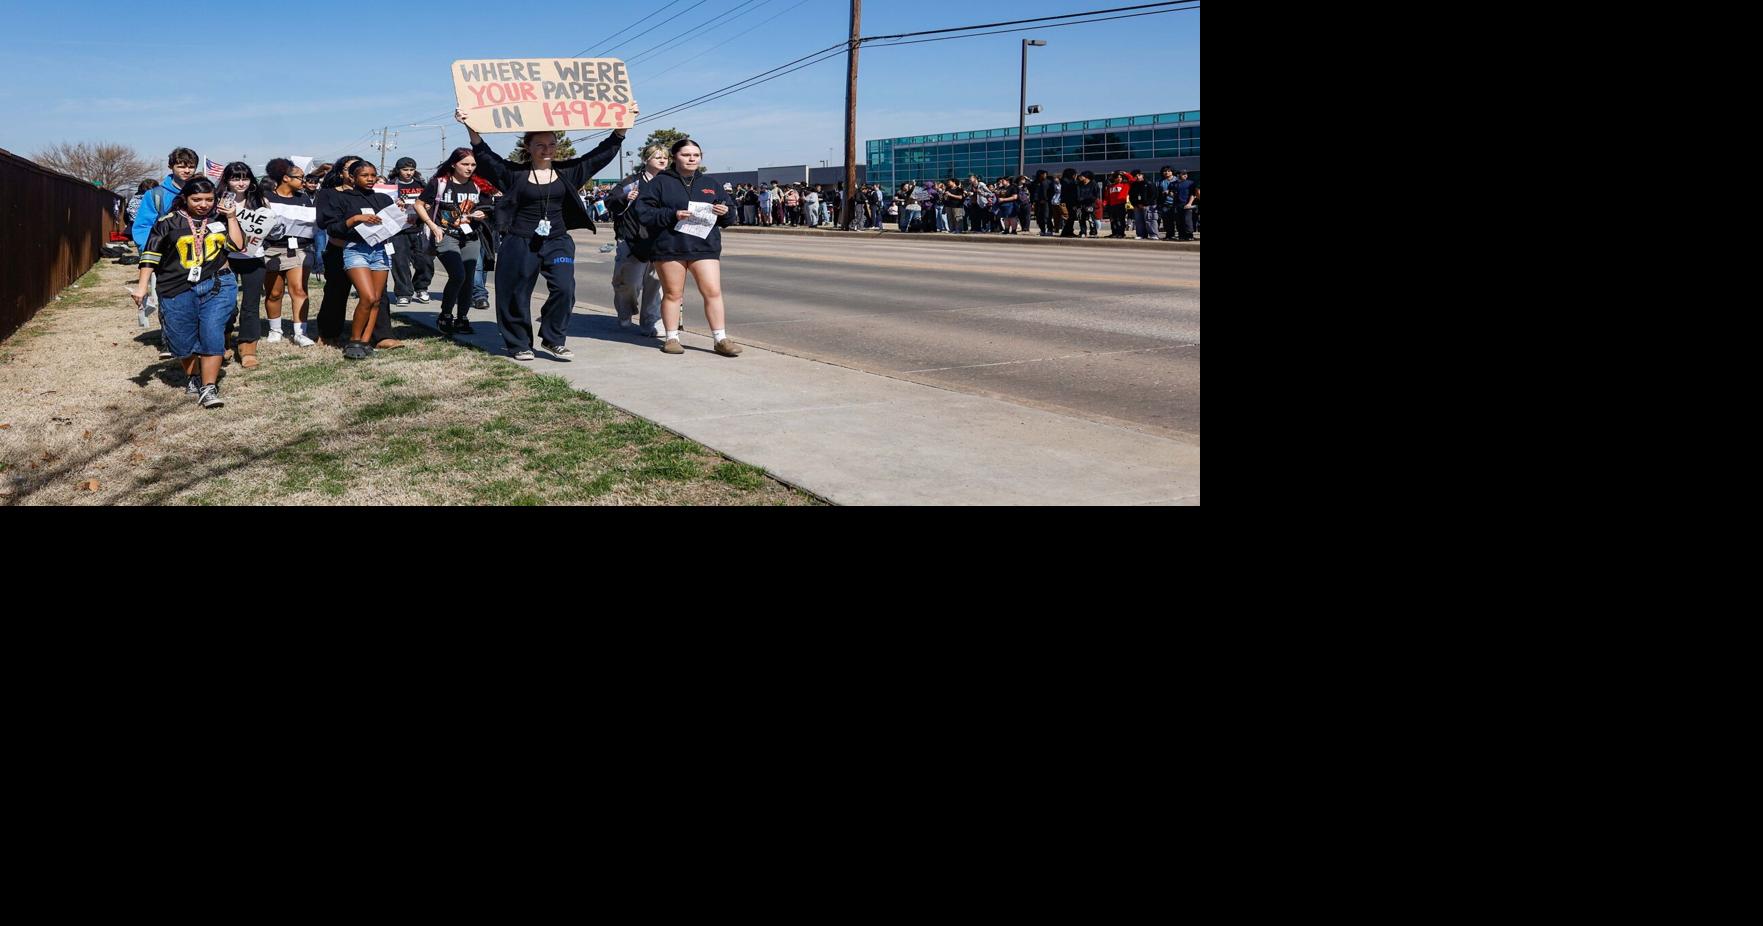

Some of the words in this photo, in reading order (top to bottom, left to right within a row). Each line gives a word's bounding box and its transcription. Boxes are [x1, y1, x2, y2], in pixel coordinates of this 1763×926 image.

[460, 61, 541, 82] WHERE
[553, 61, 628, 84] WERE
[468, 82, 538, 107] YOUR
[541, 81, 629, 104] PAPERS
[492, 105, 524, 129] IN
[543, 101, 627, 128] 1492?
[236, 209, 268, 226] AME
